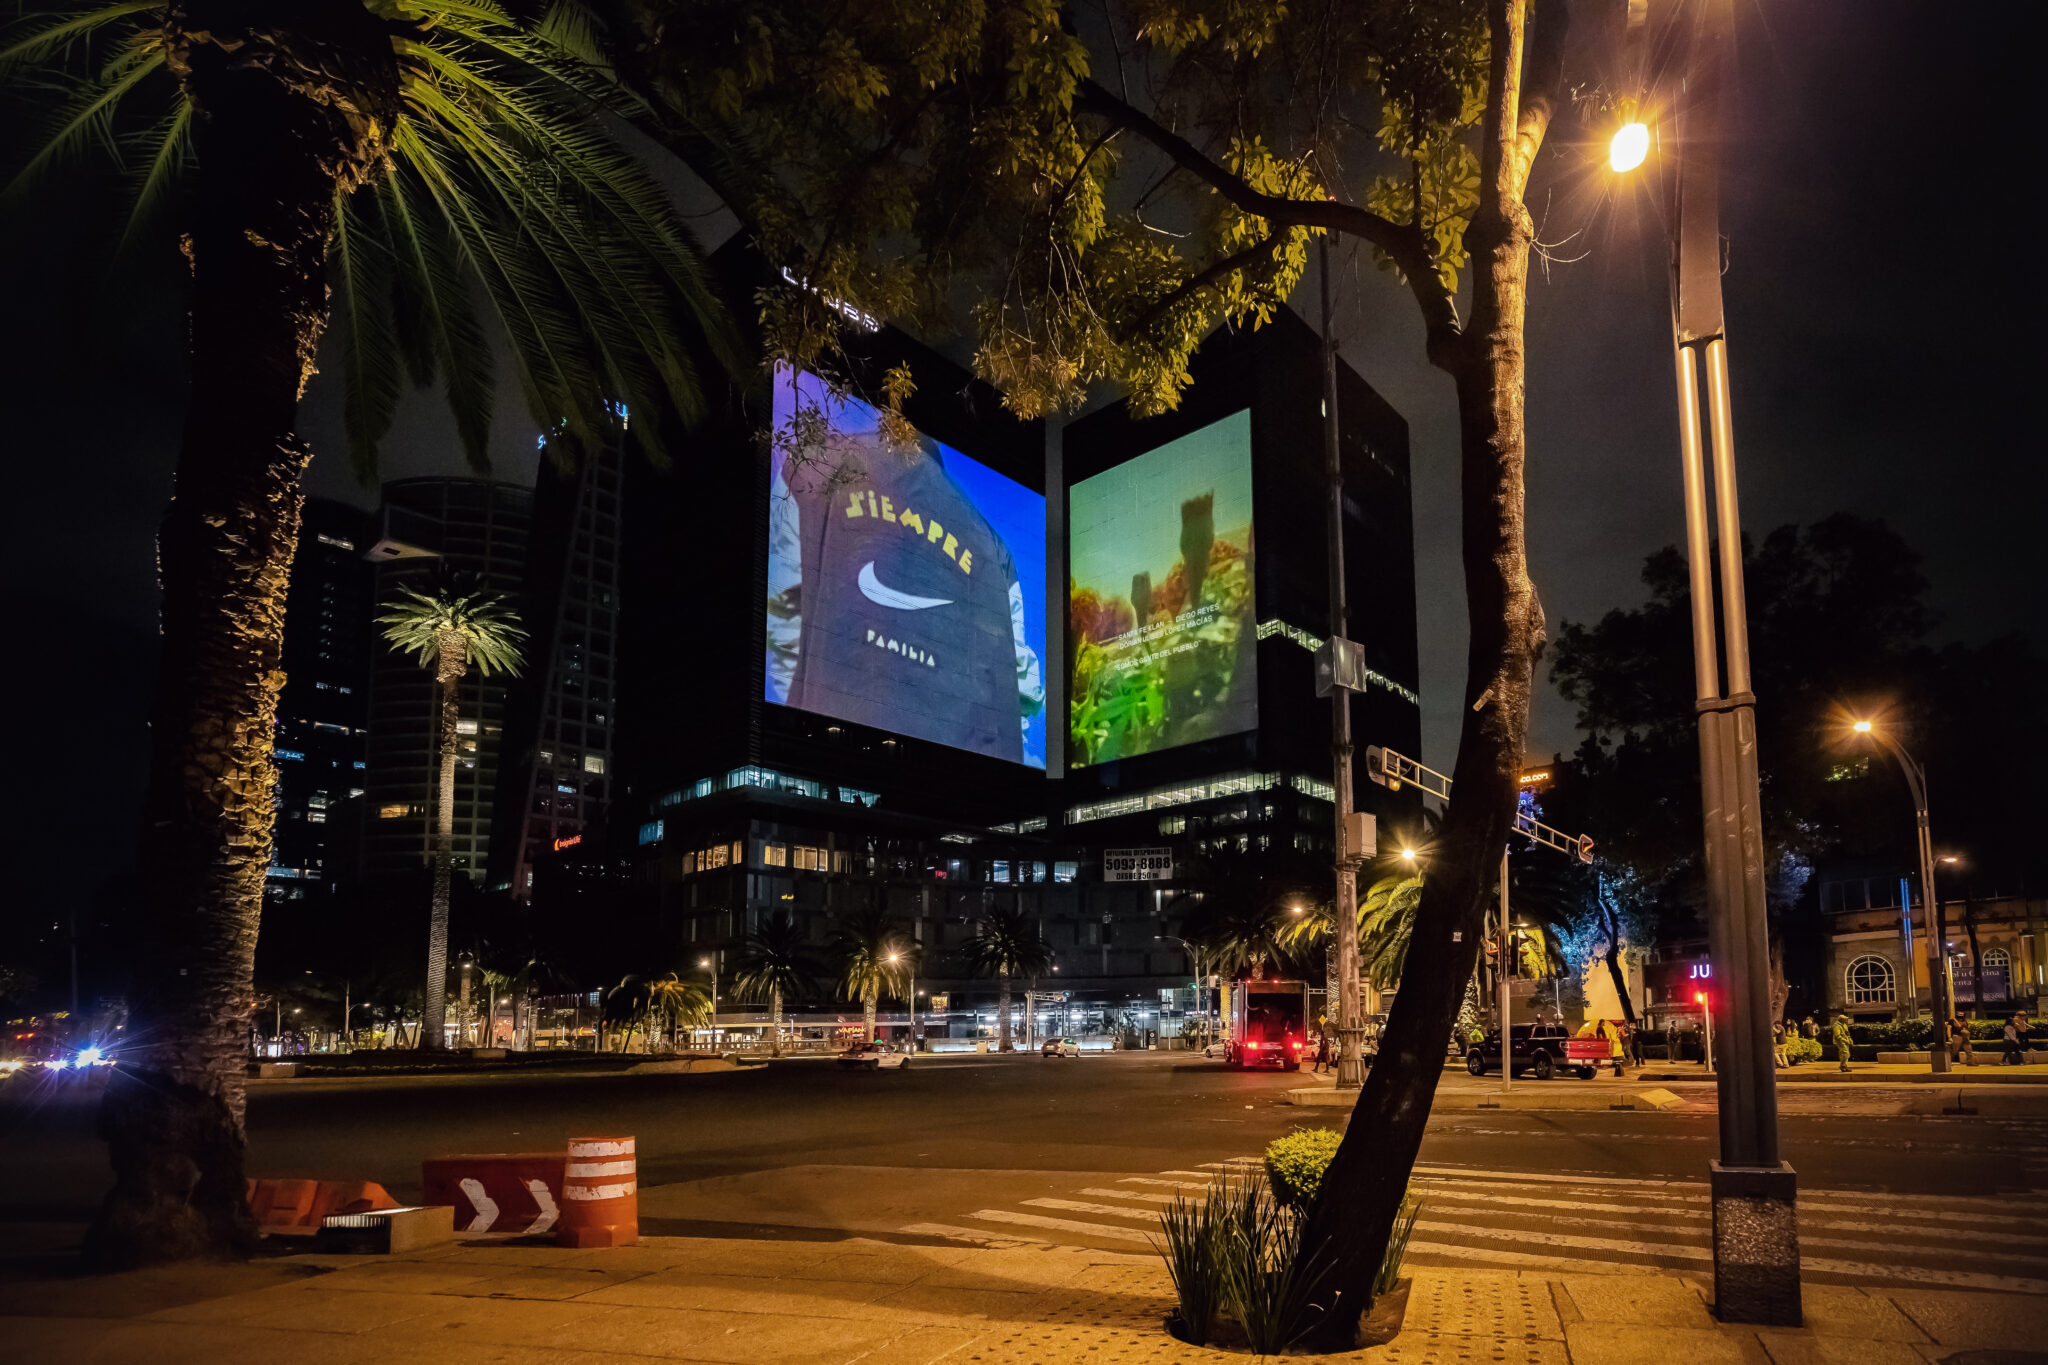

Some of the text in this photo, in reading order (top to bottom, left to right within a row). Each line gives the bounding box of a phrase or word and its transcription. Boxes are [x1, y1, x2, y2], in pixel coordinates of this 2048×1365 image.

[1175, 610, 1197, 622] DIEGO
[1197, 602, 1220, 615] REYES
[1186, 615, 1213, 628] MACÍAS
[867, 629, 936, 667] FAMILIA
[1160, 647, 1172, 658] DEL
[1116, 872, 1137, 880] DESDE
[1138, 871, 1151, 880] 250
[1690, 964, 1710, 979] JU
[838, 1025, 866, 1033] VAPIAN
